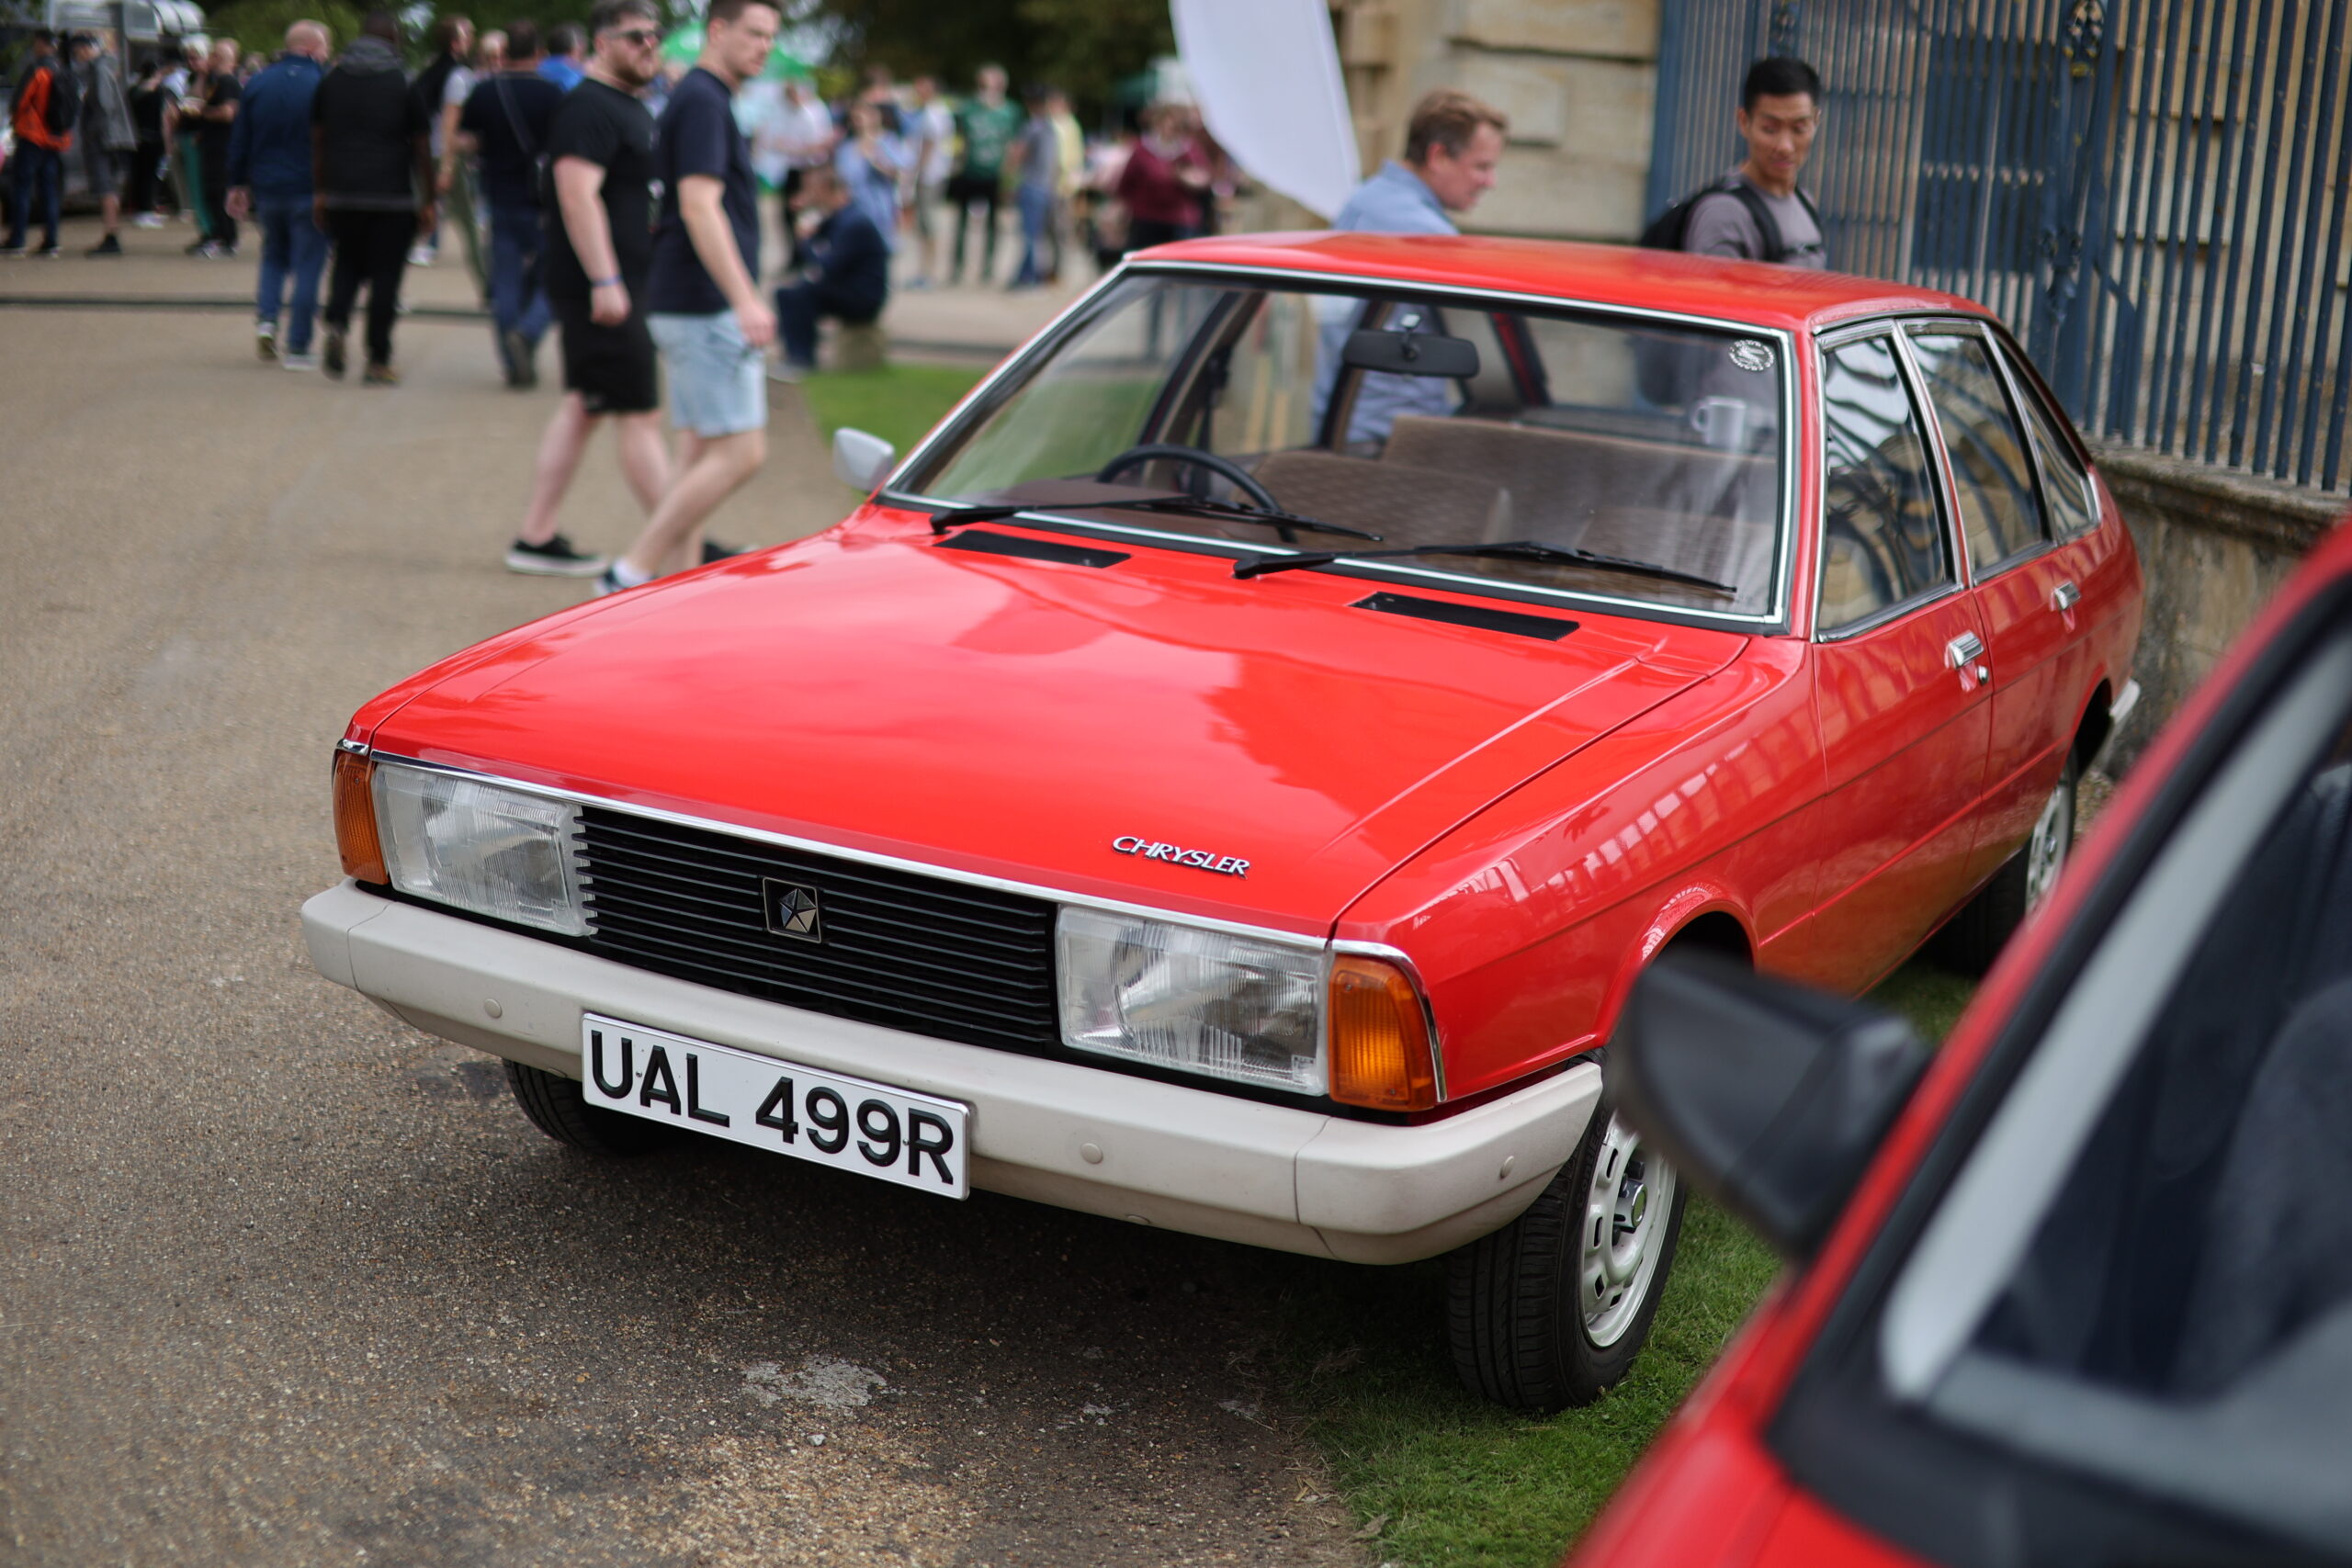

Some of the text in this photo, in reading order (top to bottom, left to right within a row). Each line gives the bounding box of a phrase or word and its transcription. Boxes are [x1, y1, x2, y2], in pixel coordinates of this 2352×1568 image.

[1112, 836, 1250, 878] CHRYSLER
[591, 1030, 954, 1185] UAL 499R
